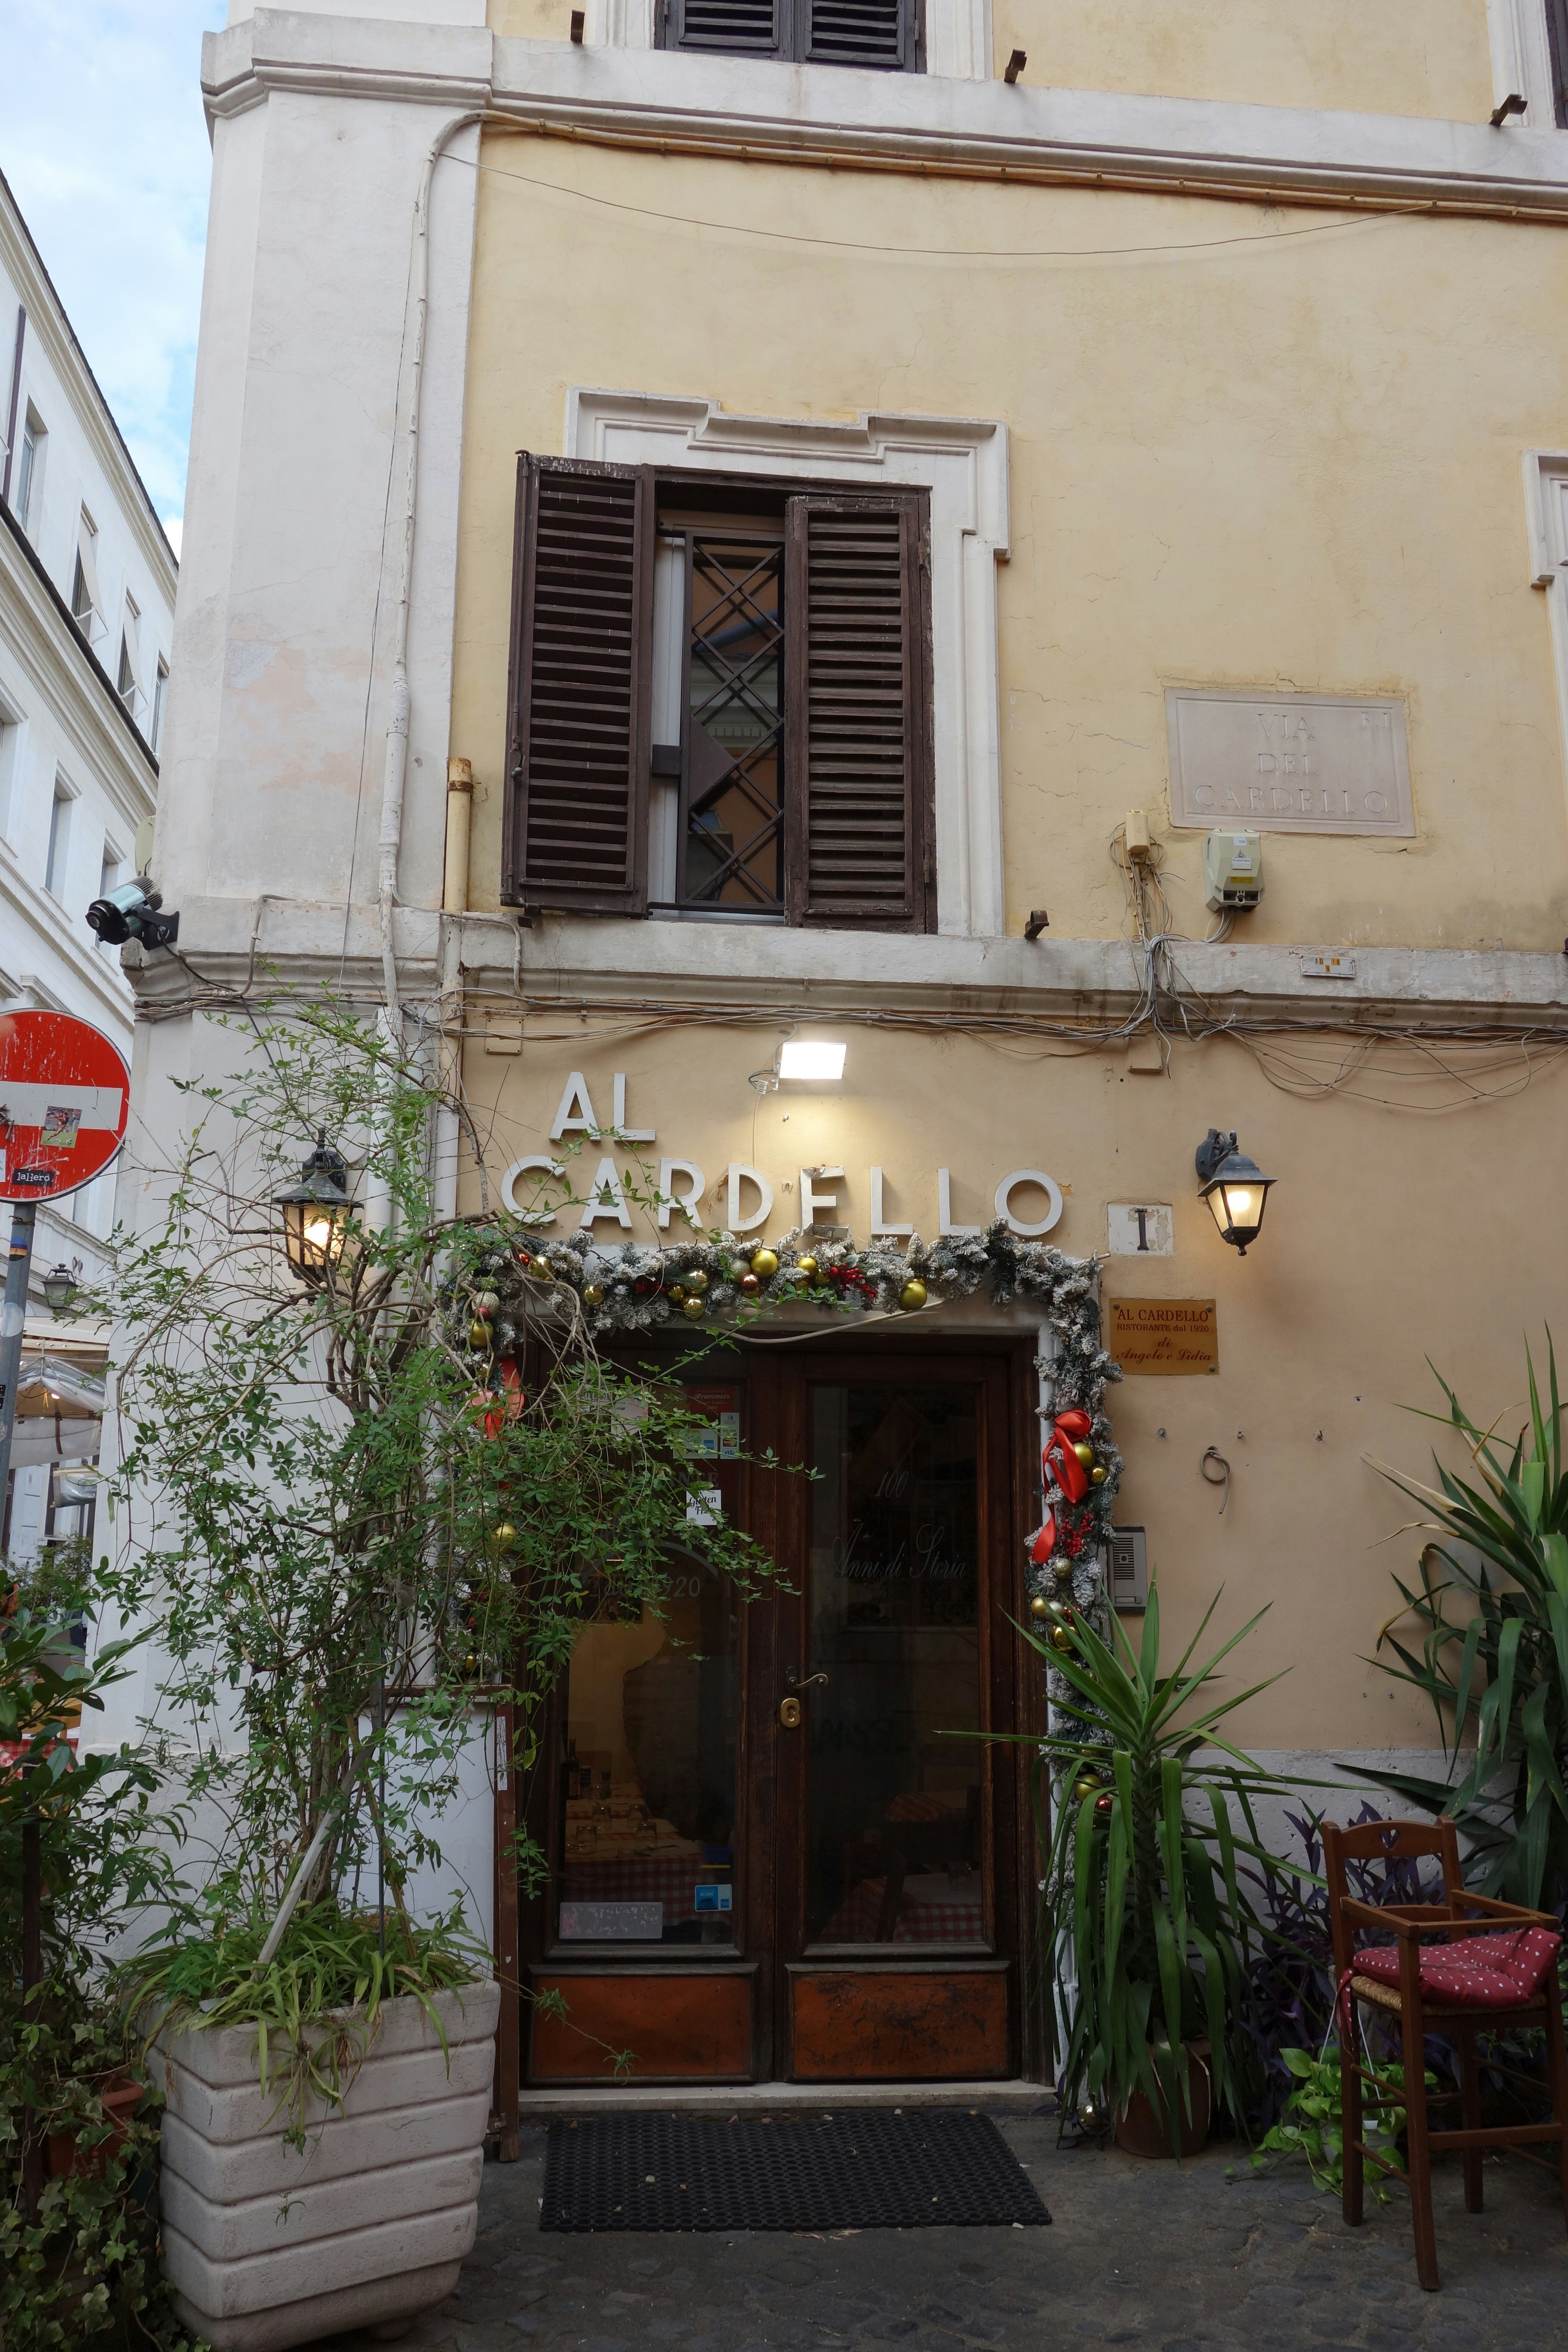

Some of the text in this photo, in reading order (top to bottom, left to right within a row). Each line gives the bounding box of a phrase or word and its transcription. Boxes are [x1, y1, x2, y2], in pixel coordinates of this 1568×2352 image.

[1256, 714, 1315, 739] VIA
[1258, 753, 1319, 775] DEL
[1195, 785, 1388, 814] CARDELLO
[549, 1072, 655, 1142] AL
[17, 1172, 50, 1182] lallero
[501, 1155, 1063, 1238] CARDELLO
[1118, 1309, 1209, 1322] AL CARDELLO
[1158, 1337, 1171, 1348] di
[1116, 1348, 1162, 1364] Angelo
[1176, 1349, 1213, 1361] Lidia
[875, 1471, 908, 1497] 100
[833, 1523, 966, 1578] Anni di Storia
